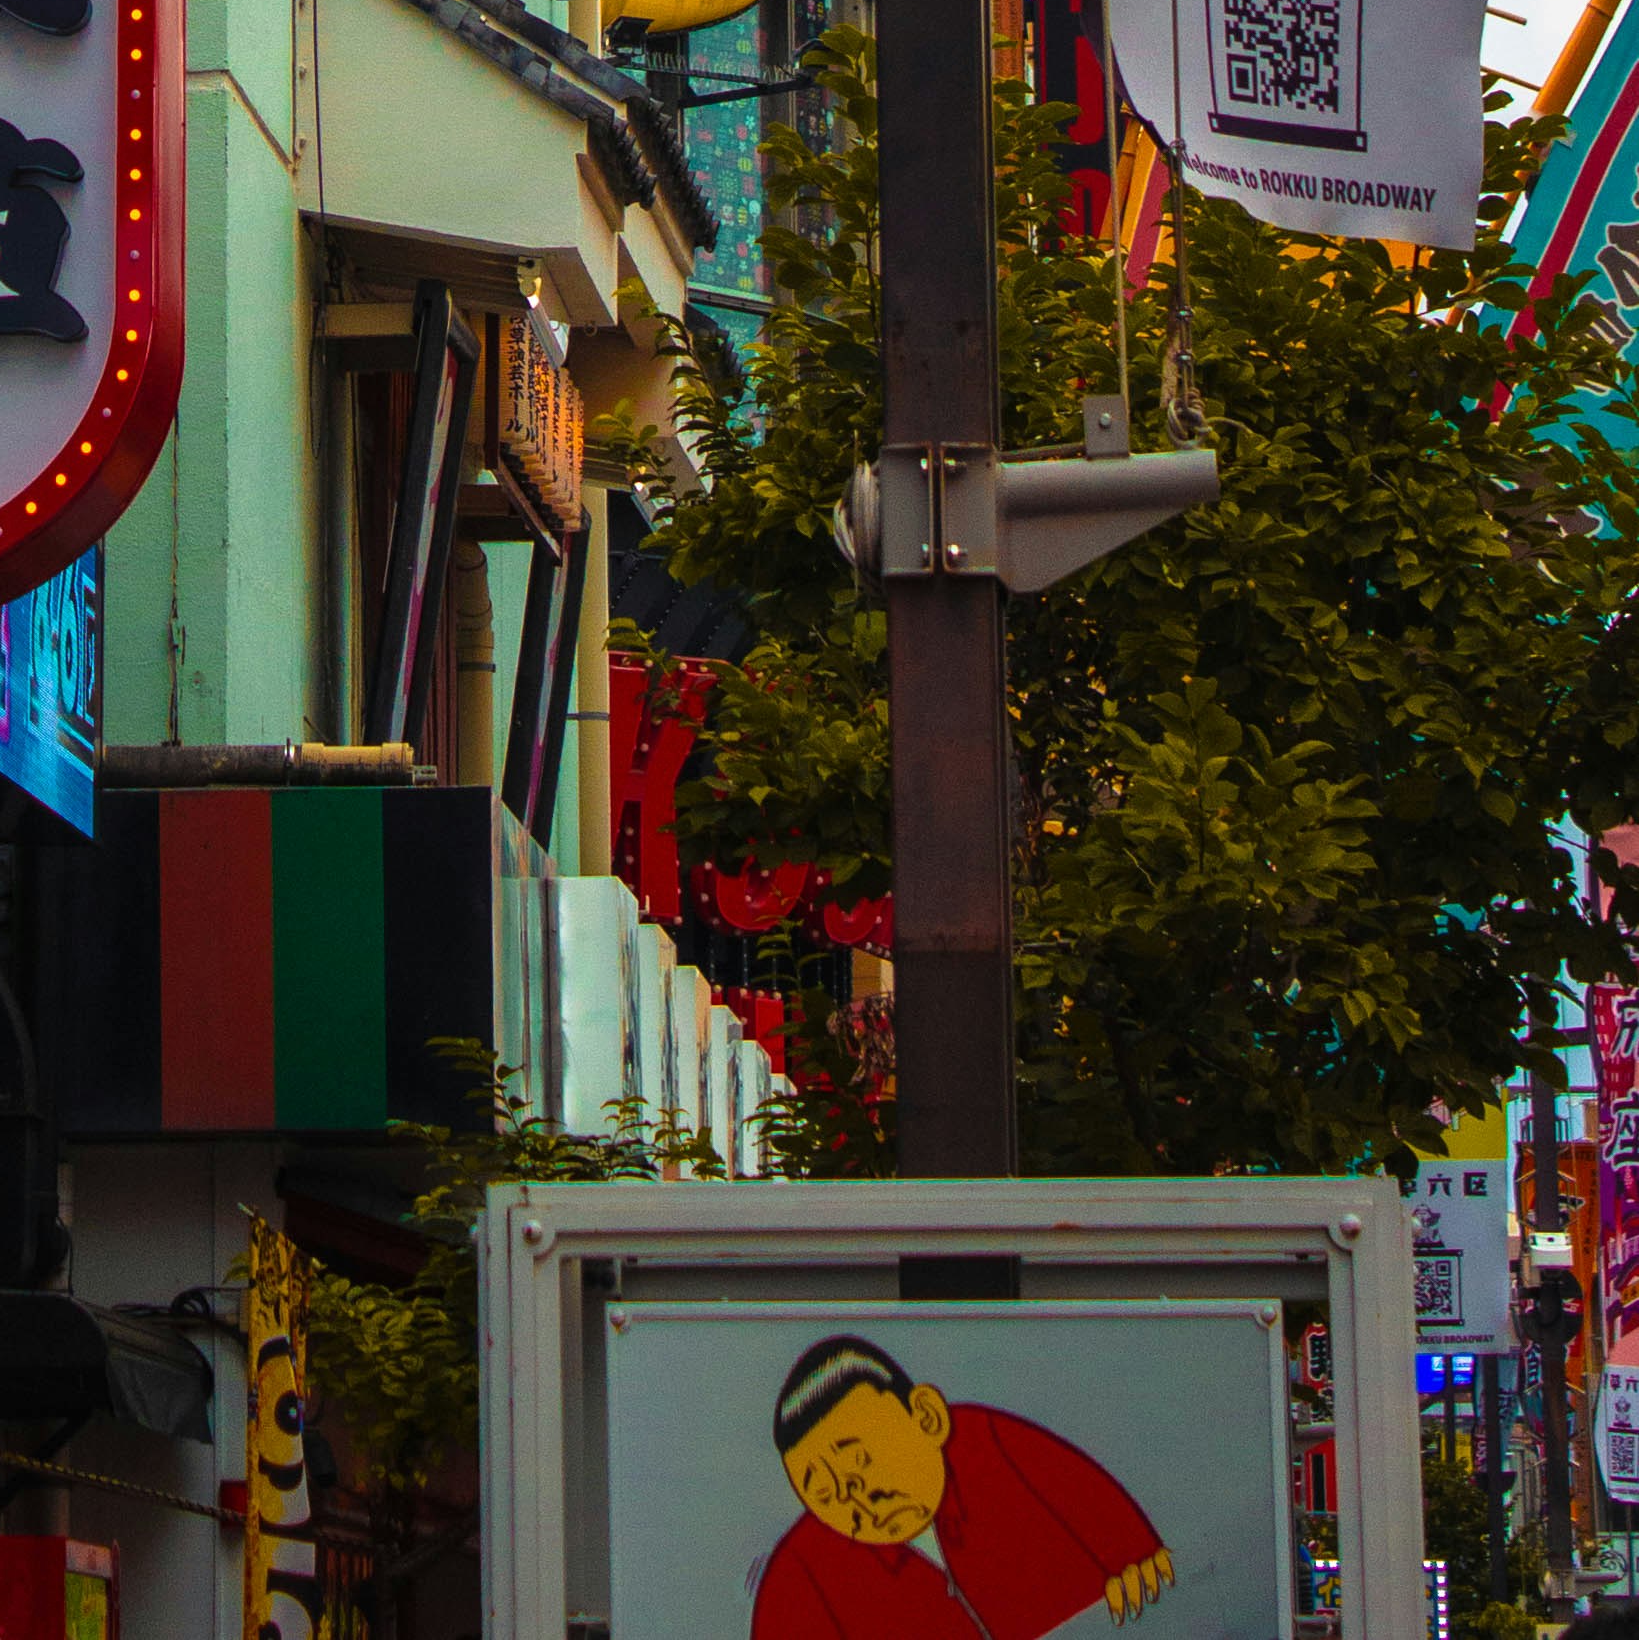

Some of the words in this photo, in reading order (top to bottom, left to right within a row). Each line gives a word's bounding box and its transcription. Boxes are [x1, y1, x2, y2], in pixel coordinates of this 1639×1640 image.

[1240, 166, 1259, 191] to
[1259, 167, 1317, 200] ROKKU
[1322, 176, 1438, 214] BROADWAY
